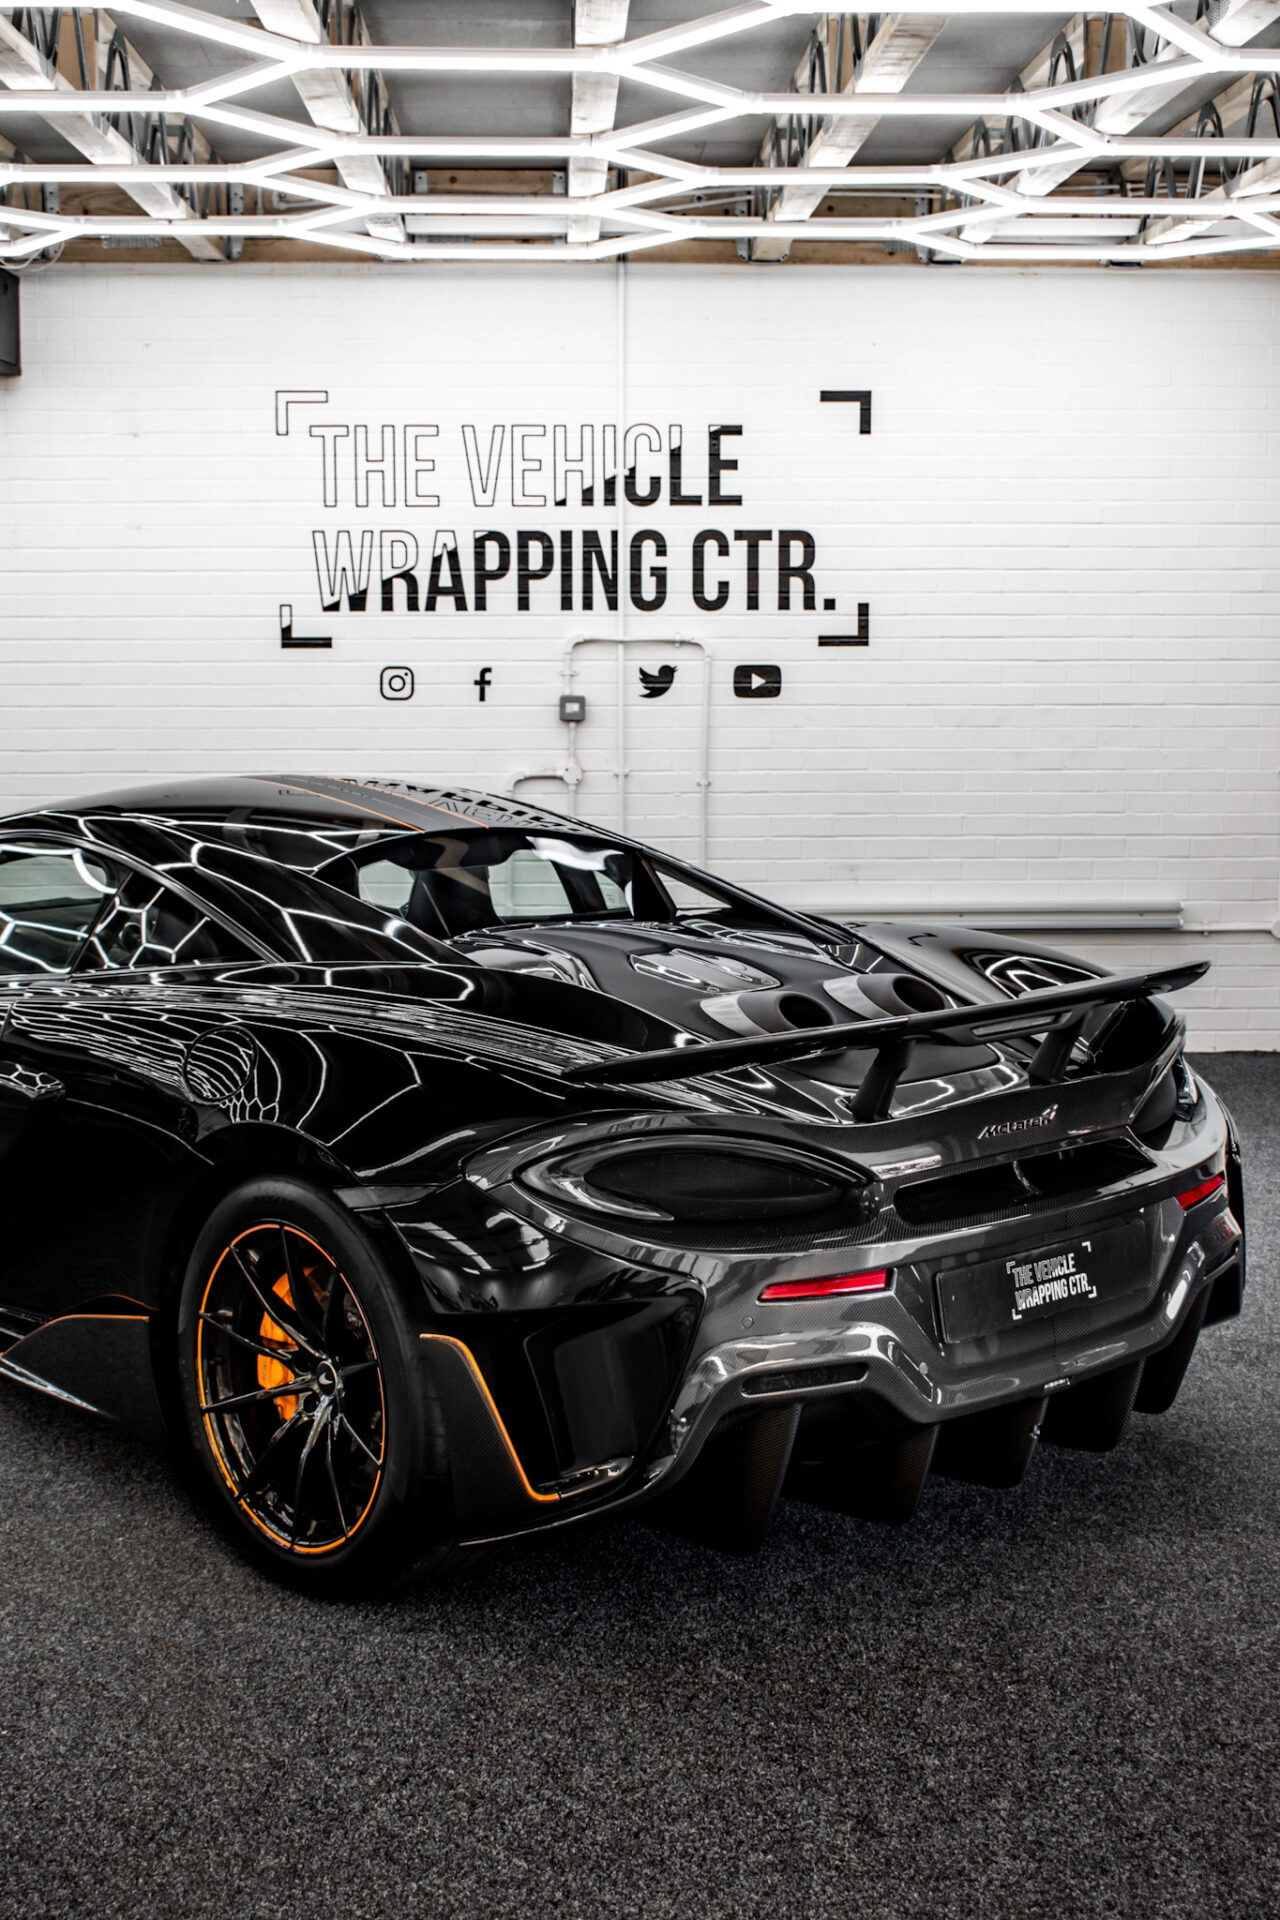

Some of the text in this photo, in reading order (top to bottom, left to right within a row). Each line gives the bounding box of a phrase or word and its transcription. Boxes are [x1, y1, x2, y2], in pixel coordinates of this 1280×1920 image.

[309, 423, 743, 507] THE VEHICLE
[312, 529, 836, 612] WRAPPING CTR.
[1011, 1253, 1076, 1288] THE VEHICLE
[1014, 1272, 1092, 1311] WRAPPING CTR.
